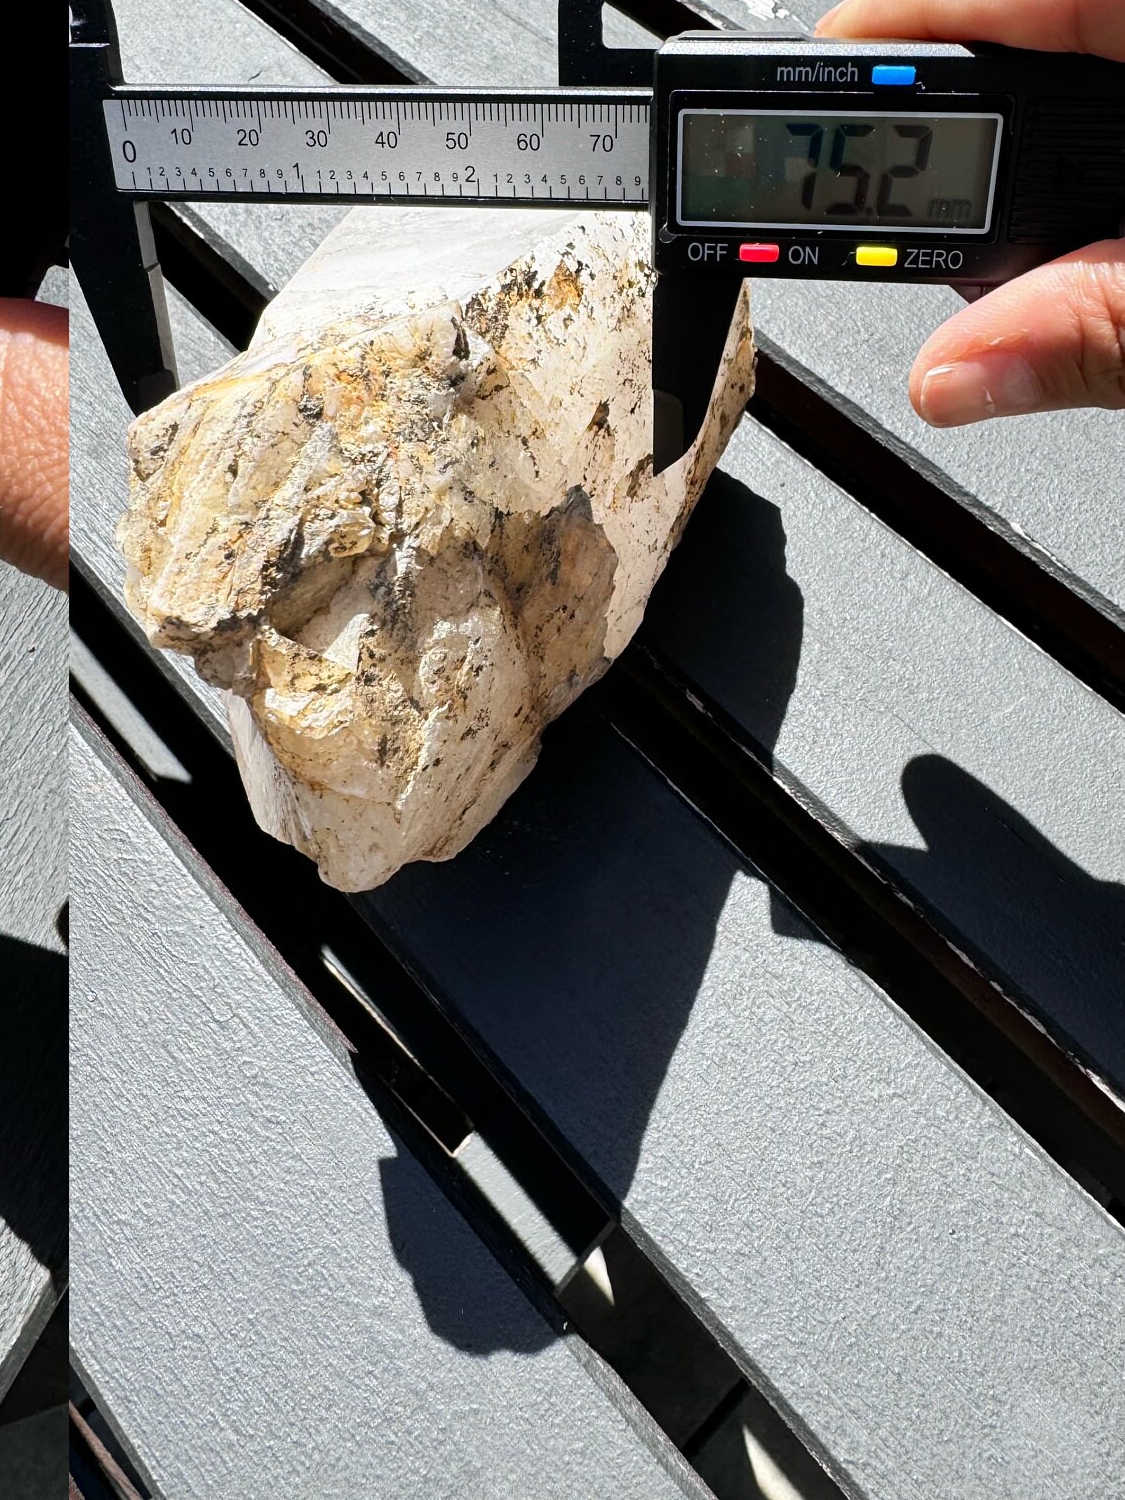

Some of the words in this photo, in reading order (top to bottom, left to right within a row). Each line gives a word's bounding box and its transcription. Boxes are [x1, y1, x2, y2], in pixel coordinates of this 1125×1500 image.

[777, 62, 857, 82] mm/inch
[122, 140, 137, 163] 0
[170, 128, 192, 145] 10
[237, 129, 259, 147] 20
[305, 130, 328, 148] 30
[374, 131, 398, 149] 40
[445, 132, 468, 150] 50
[517, 133, 540, 151] 60
[589, 134, 613, 152] 70
[147, 166, 151, 176] 1
[159, 166, 165, 177] 2
[175, 166, 182, 177] 3
[191, 167, 197, 177] 4
[208, 167, 215, 178] 5
[225, 168, 232, 178] 6
[242, 168, 248, 178] 7
[259, 168, 266, 178] 8
[276, 168, 283, 179] 9
[292, 162, 300, 179] 1
[316, 169, 321, 179] 1
[329, 170, 336, 180] 2
[346, 170, 353, 180] 3
[362, 170, 369, 180] 4
[381, 171, 388, 181] 5
[398, 171, 405, 182] 6
[416, 171, 422, 182] 7
[434, 172, 441, 182] 8
[451, 172, 459, 182] 9
[465, 165, 476, 183] 2
[493, 173, 498, 183] 1
[506, 173, 513, 184] 2
[524, 173, 531, 184] 3
[541, 174, 548, 184] 4
[560, 174, 567, 185] 5
[579, 175, 586, 185] 6
[597, 175, 604, 185] 7
[615, 175, 622, 186] 8
[634, 176, 641, 186] 9
[930, 199, 972, 220] mm
[688, 243, 727, 261] OFF
[789, 246, 818, 264] ON
[905, 249, 962, 269] ZERO
